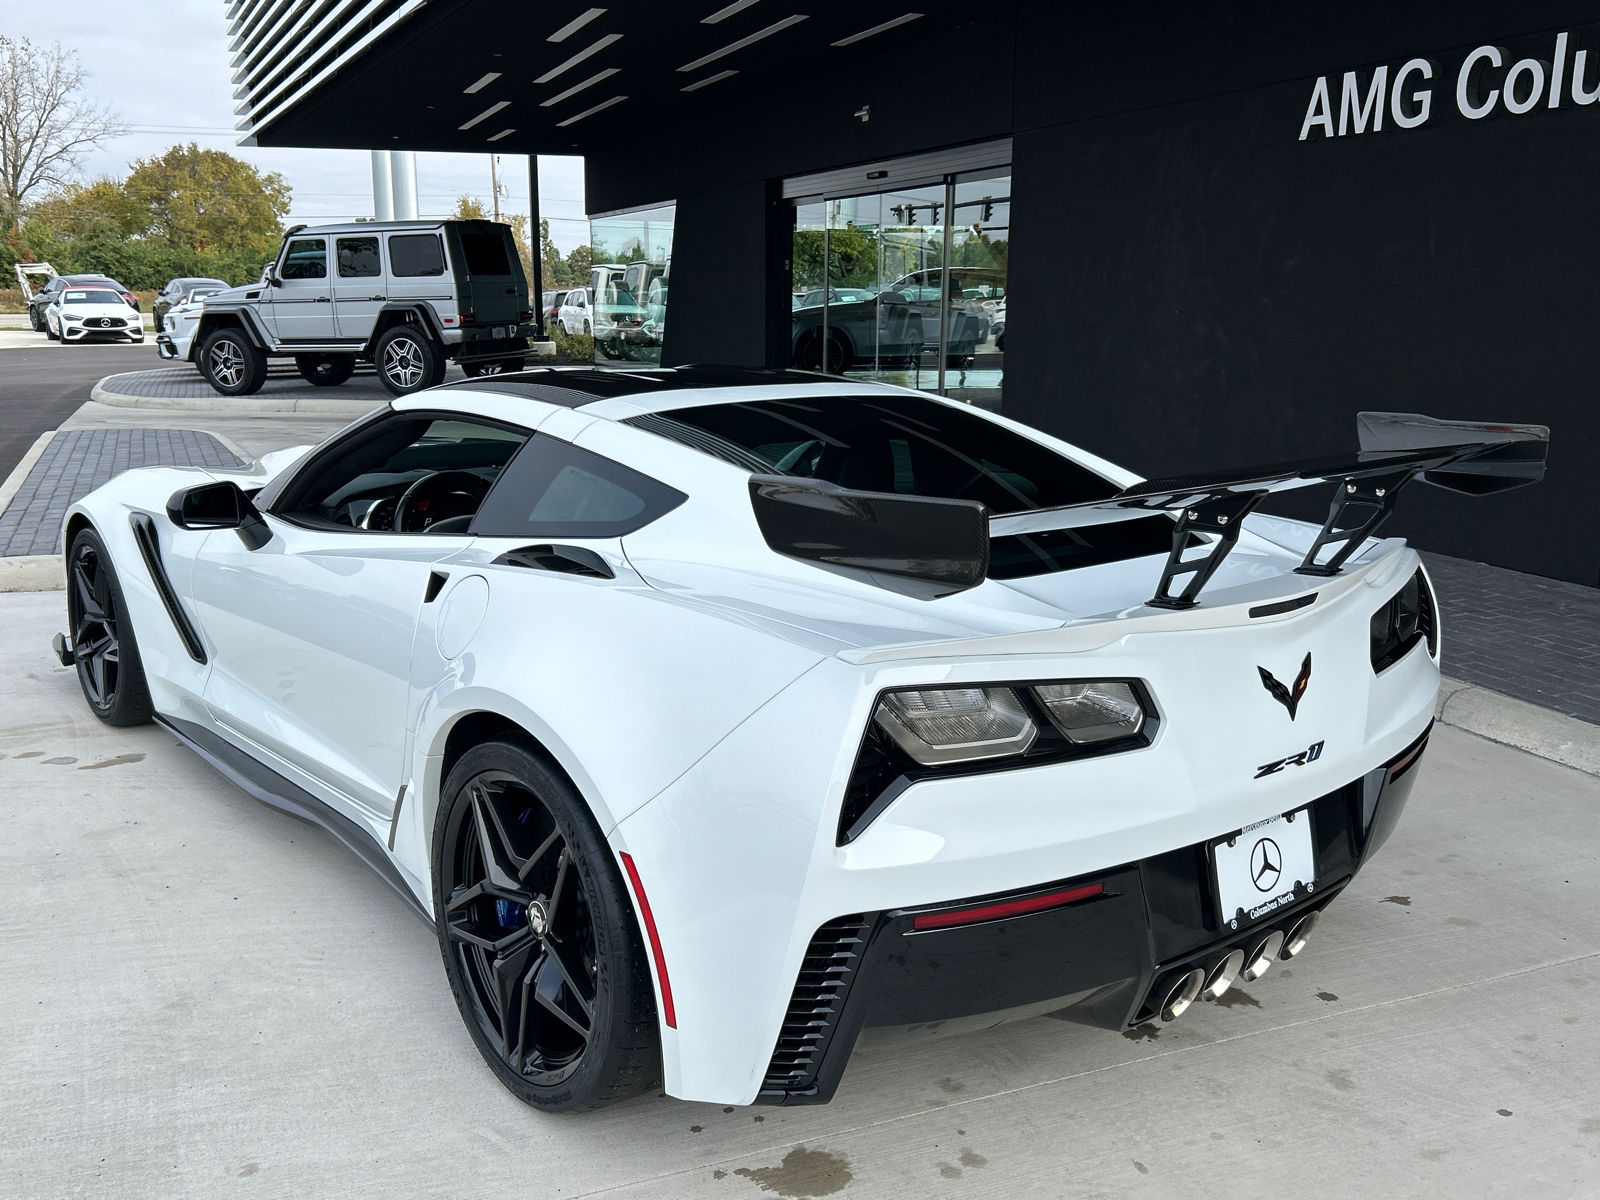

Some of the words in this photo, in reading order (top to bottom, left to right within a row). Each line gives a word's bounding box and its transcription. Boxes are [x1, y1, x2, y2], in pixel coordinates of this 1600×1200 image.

[1299, 58, 1433, 141] AMG
[1456, 32, 1600, 120] Colu
[1253, 739, 1325, 780] ZR1
[585, 876, 607, 956] MICHELIN
[1250, 900, 1278, 920] Columbus
[1278, 892, 1295, 907] North
